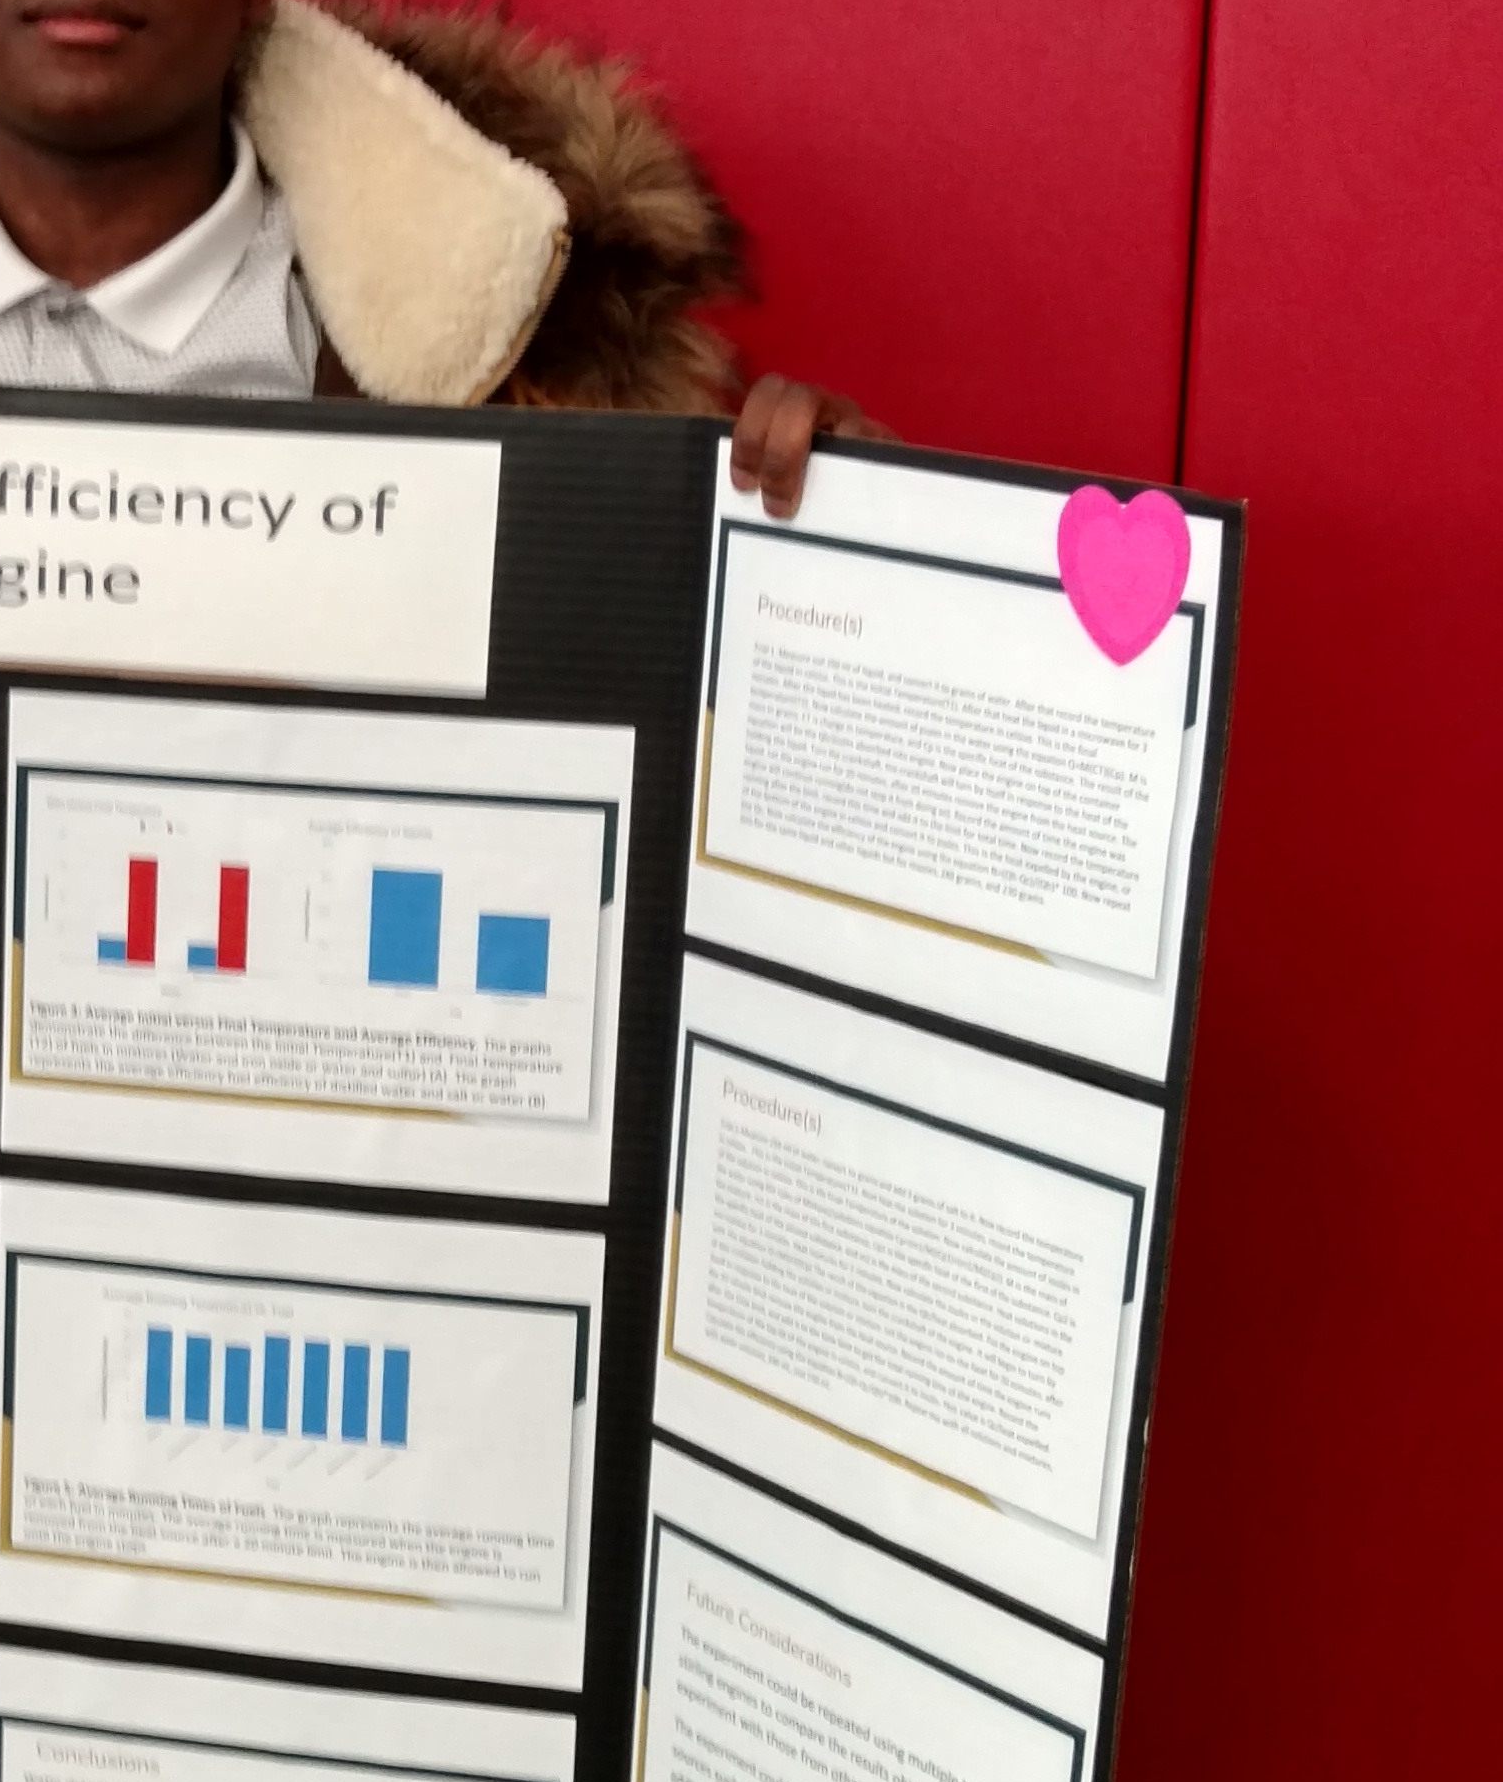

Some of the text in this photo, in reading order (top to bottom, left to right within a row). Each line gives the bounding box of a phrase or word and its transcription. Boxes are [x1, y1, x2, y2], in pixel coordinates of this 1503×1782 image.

[320, 482, 399, 537] of
[757, 594, 863, 639] Procedure(s)
[722, 1077, 822, 1137] Procedure(s)
[686, 1580, 853, 1689] Future Considerations
[680, 1625, 700, 1651] The
[702, 1641, 764, 1686] experiment
[767, 1675, 798, 1704] could
[800, 1689, 814, 1713] be
[817, 1702, 870, 1743] repeated
[873, 1733, 904, 1764] using
[674, 1717, 693, 1742] The
[695, 1734, 756, 1778] experiment
[676, 1685, 736, 1726] experiment
[739, 1719, 763, 1741] with
[766, 1730, 797, 1760] those
[800, 1749, 828, 1777] from
[716, 1676, 757, 1710] engines
[760, 1696, 771, 1717] to
[775, 1709, 824, 1746] compare
[827, 1733, 847, 1759] the
[850, 1749, 889, 1782] results
[672, 1748, 711, 1780] sources
